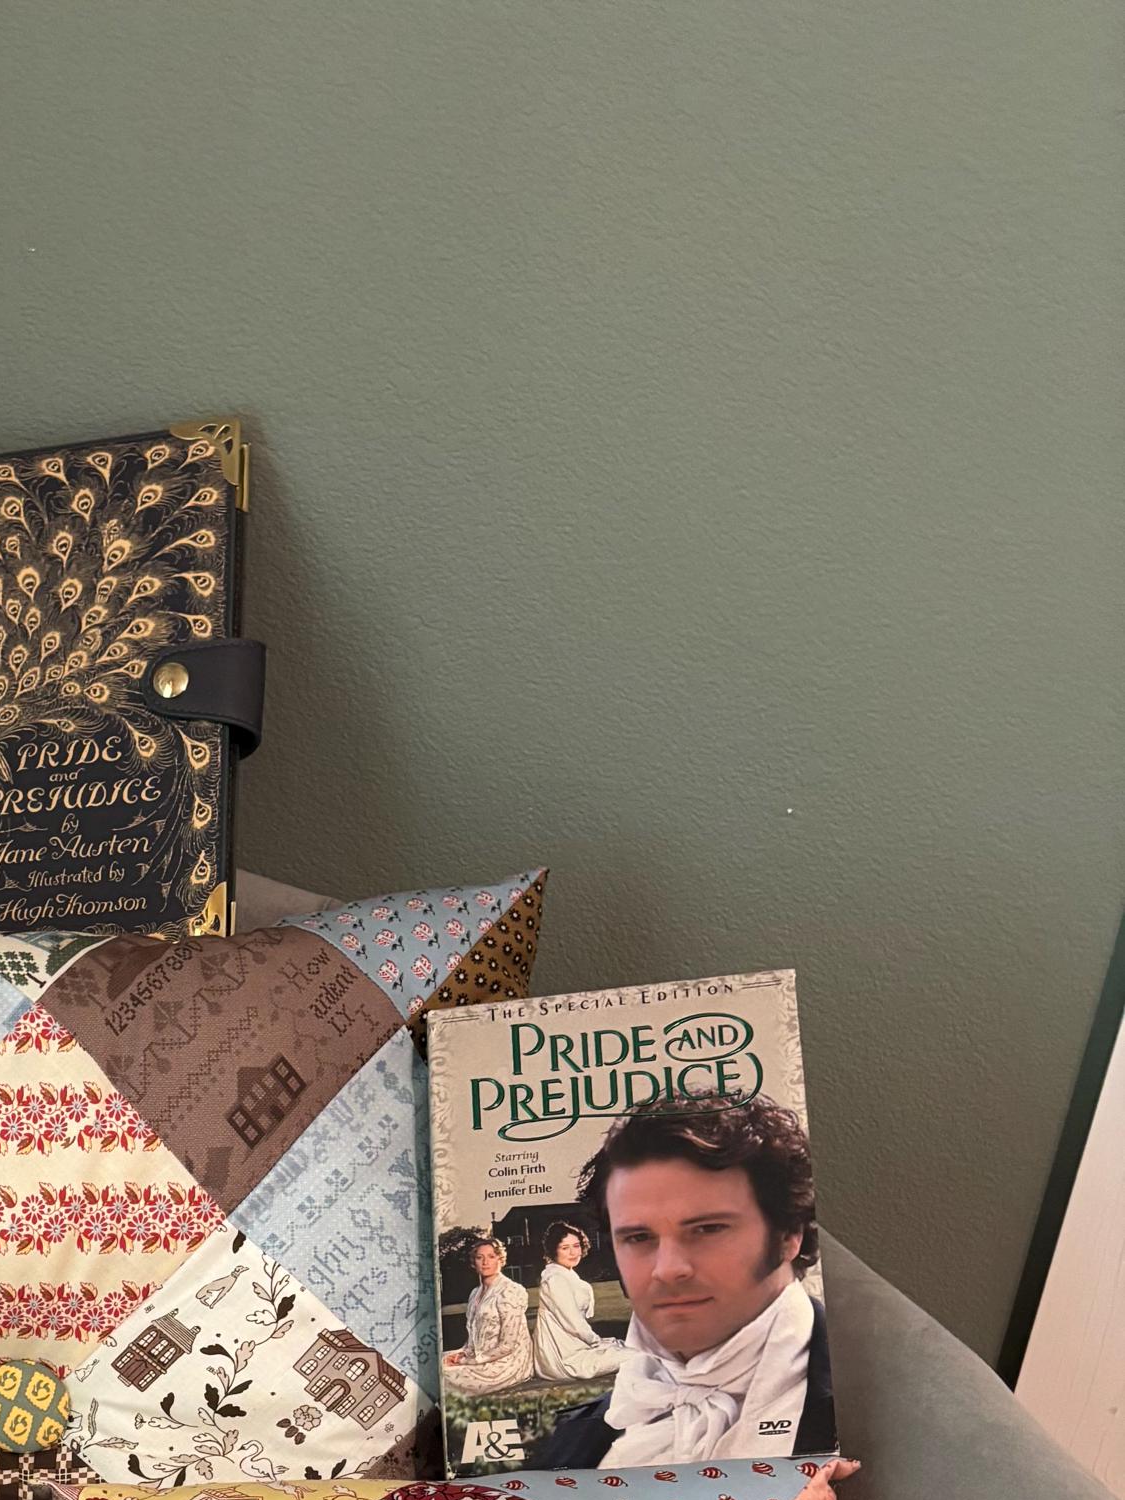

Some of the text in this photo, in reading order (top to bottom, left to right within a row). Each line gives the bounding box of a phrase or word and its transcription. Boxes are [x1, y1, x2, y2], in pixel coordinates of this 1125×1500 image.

[15, 735, 124, 772] PRIDE
[49, 769, 81, 784] and
[61, 815, 80, 834] by
[49, 833, 152, 861] Austen
[26, 865, 127, 889] Illustrated by
[56, 891, 149, 919] Thomson
[487, 983, 735, 1023] THE SPECIAL EDITION
[509, 1018, 747, 1076] PRIDE AND
[470, 1053, 764, 1140] PREJUDICE
[494, 1150, 540, 1163] Starring
[488, 1163, 546, 1178] Colin Firth
[509, 1175, 527, 1185] and
[483, 1184, 553, 1201] Jennifer Ehle
[758, 1419, 792, 1431] DVD
[460, 1419, 525, 1464] A&E
